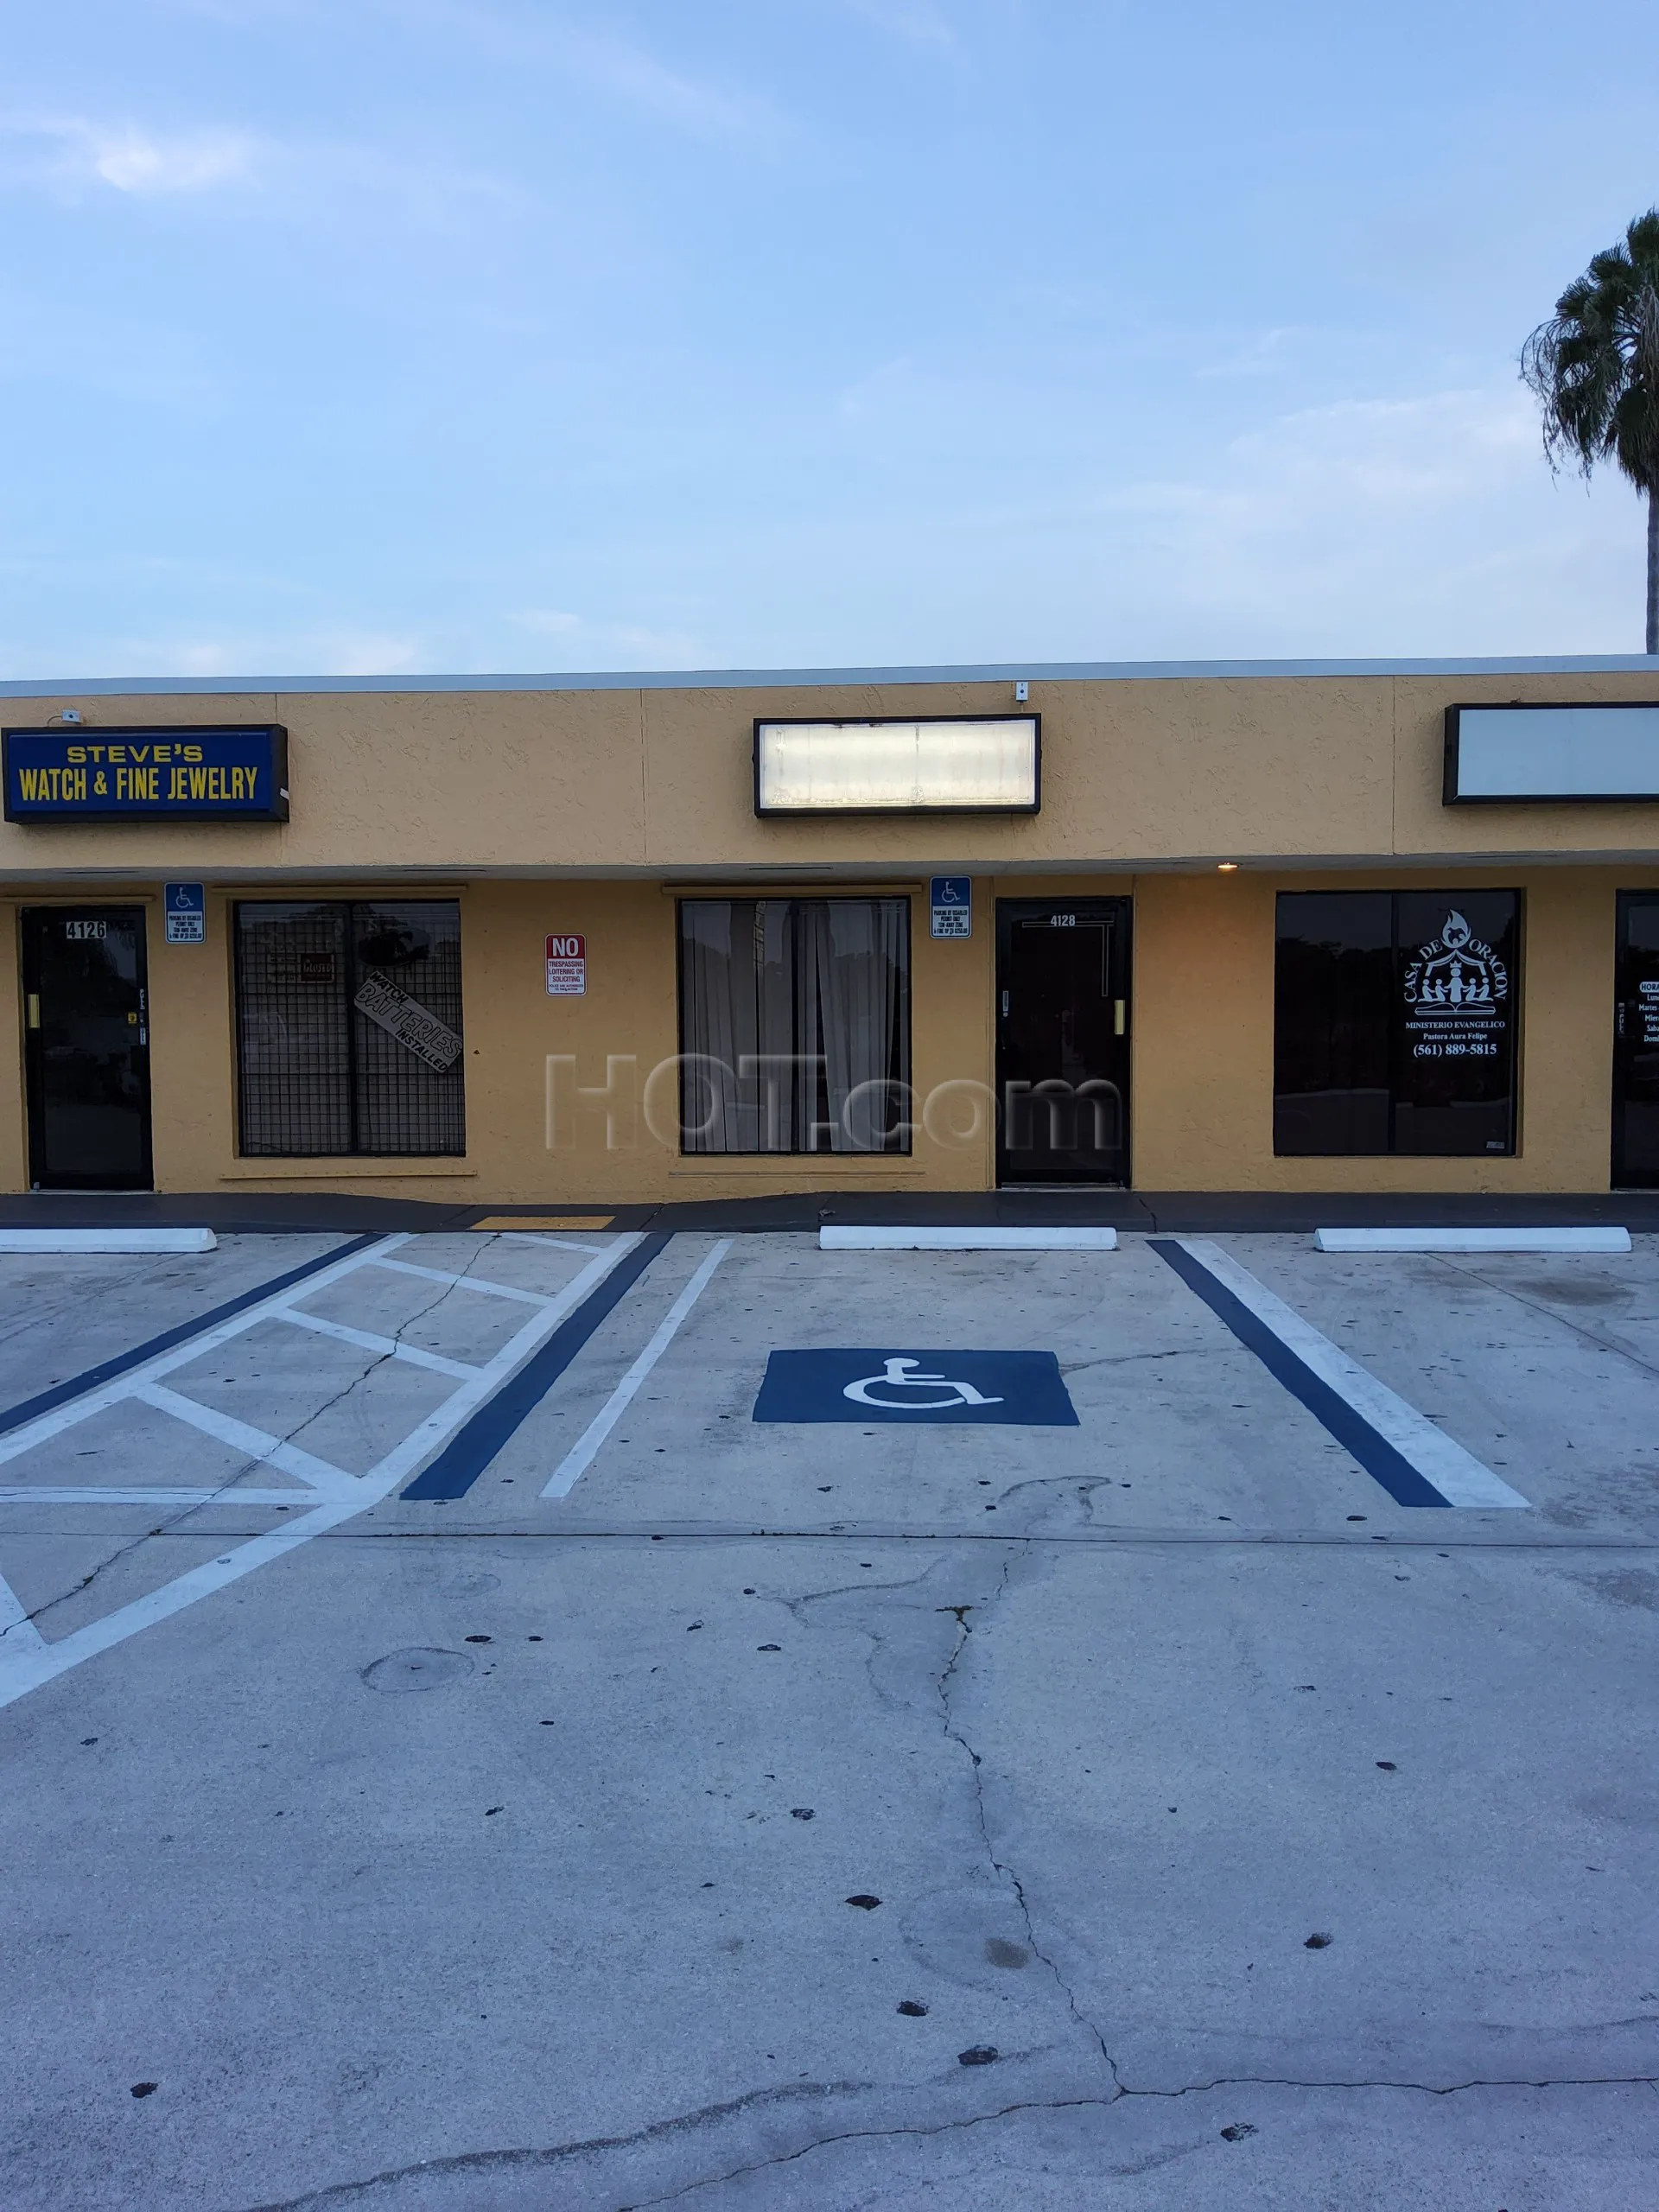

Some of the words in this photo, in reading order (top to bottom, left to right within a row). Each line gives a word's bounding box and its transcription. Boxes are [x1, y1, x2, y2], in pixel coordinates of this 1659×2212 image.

[67, 743, 203, 763] STEVE'S
[19, 768, 86, 800] WATCH
[93, 771, 107, 795] &
[117, 767, 159, 800] FINE
[167, 766, 257, 800] JEWELRY
[1051, 914, 1076, 926] 4128
[68, 922, 105, 938] 4126
[552, 938, 579, 957] NO
[1404, 963, 1422, 1002] CASA
[1419, 939, 1443, 960] DE
[1469, 938, 1508, 1000] ORACION
[369, 972, 409, 1002] WATCH
[354, 983, 463, 1058] BATTERIES
[1454, 1020, 1506, 1029] EVANGELICO
[1467, 1033, 1488, 1041] Felipe
[395, 1028, 448, 1071] INSTALLED
[1413, 1044, 1443, 1058] (561)
[1445, 1044, 1497, 1055] 889-5815
